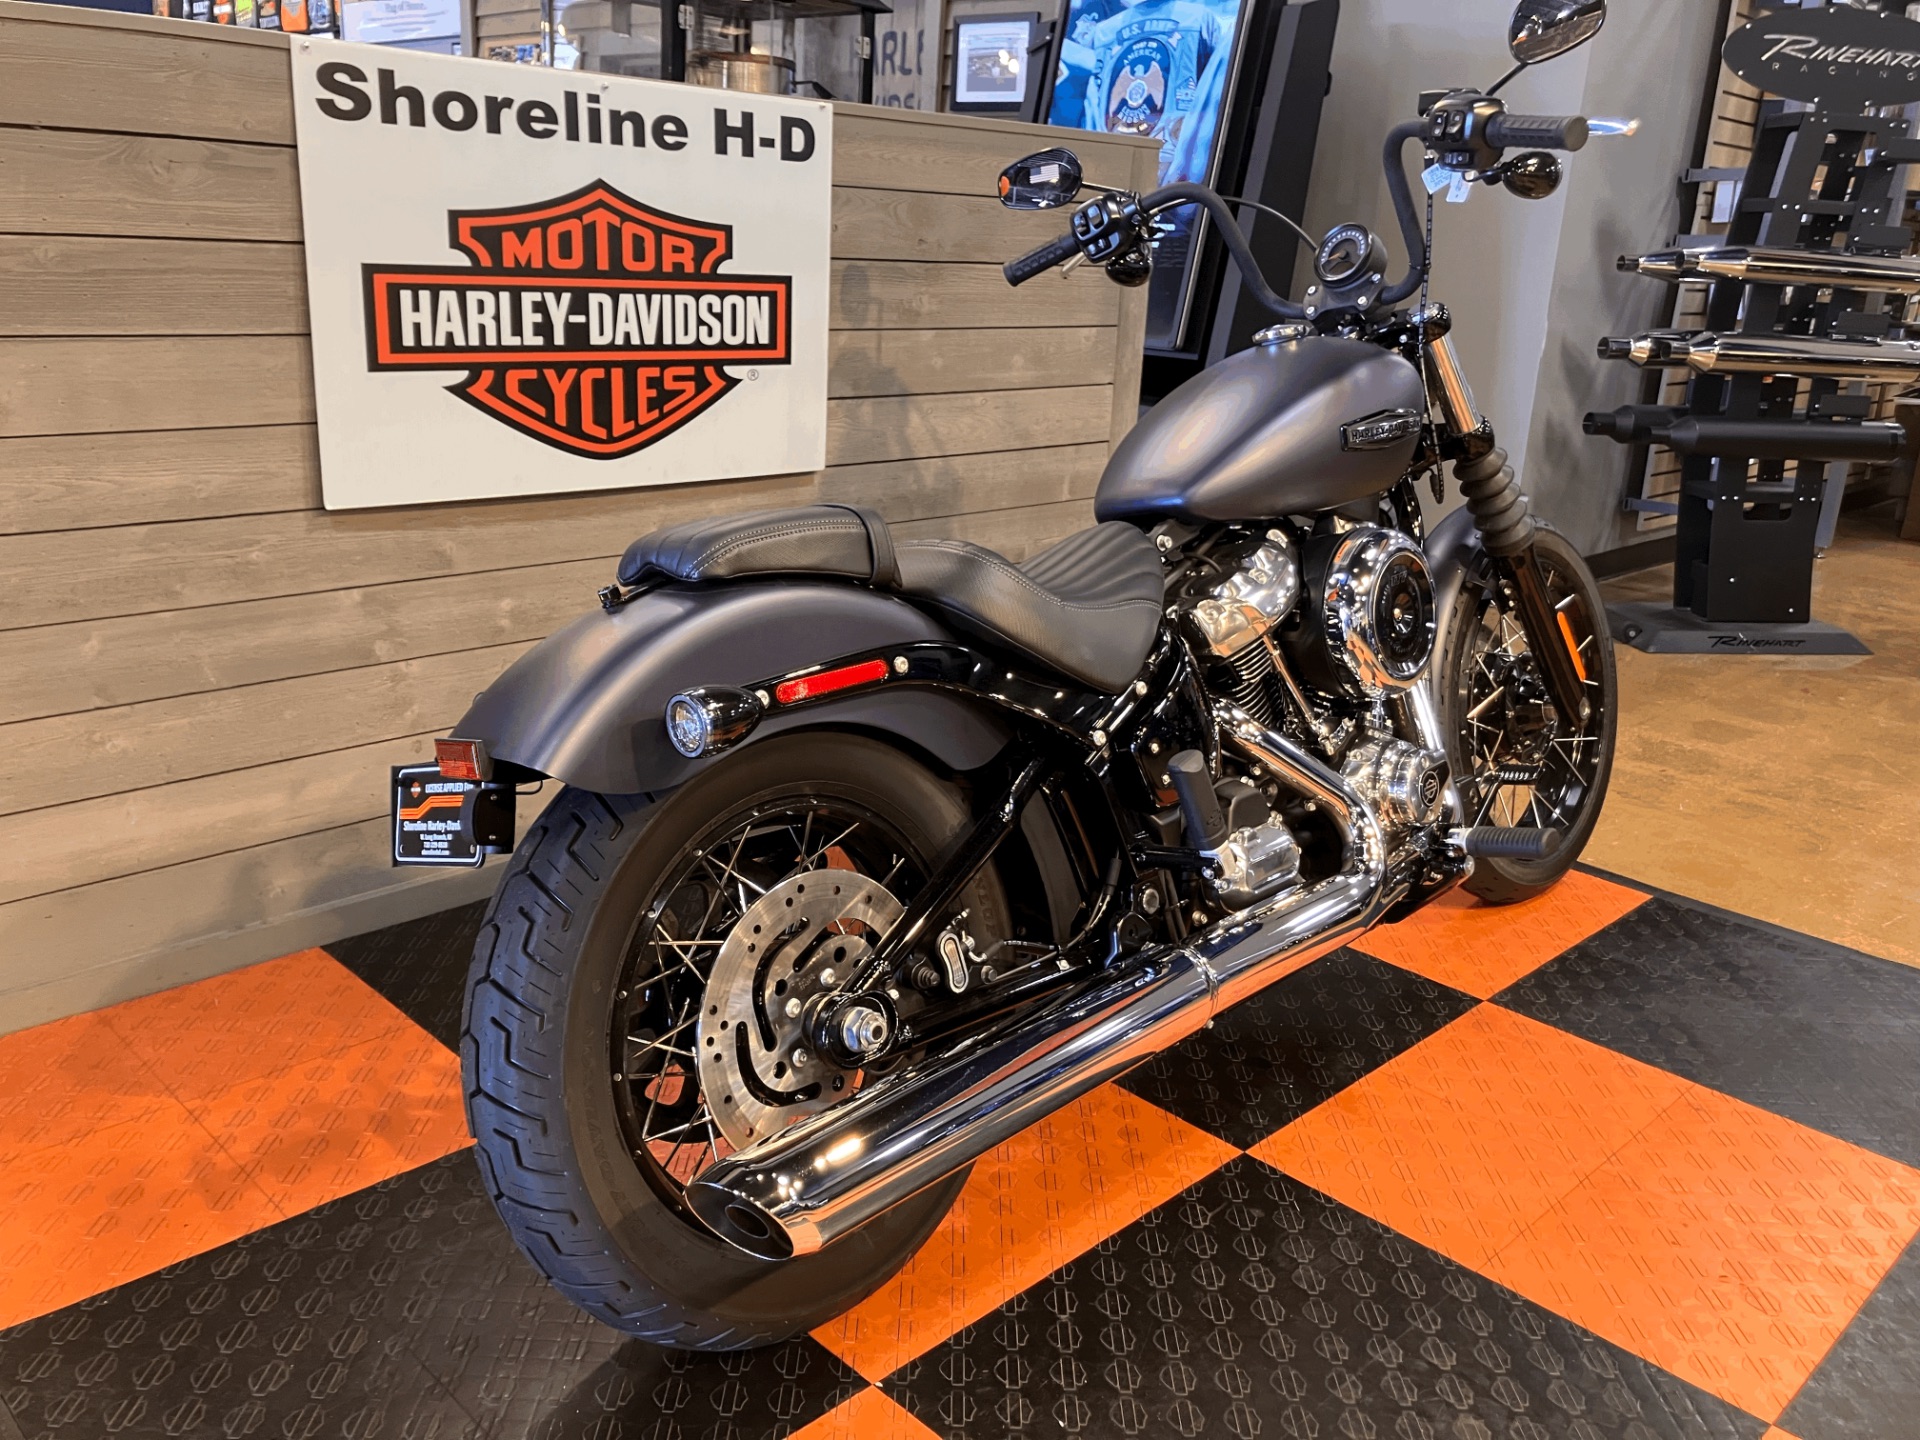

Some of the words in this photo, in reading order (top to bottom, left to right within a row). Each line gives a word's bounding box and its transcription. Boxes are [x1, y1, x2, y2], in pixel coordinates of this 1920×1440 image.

[1772, 62, 1916, 81] RACING
[315, 60, 688, 151] Shoreline
[713, 107, 816, 163] H-D
[502, 207, 696, 274] MOTOR
[400, 288, 770, 348] HARLEY-DAVIDSON
[505, 366, 696, 440] CYCLES
[1351, 417, 1421, 442] HARLEY-DAVSN
[1707, 635, 1806, 648] RINEHART
